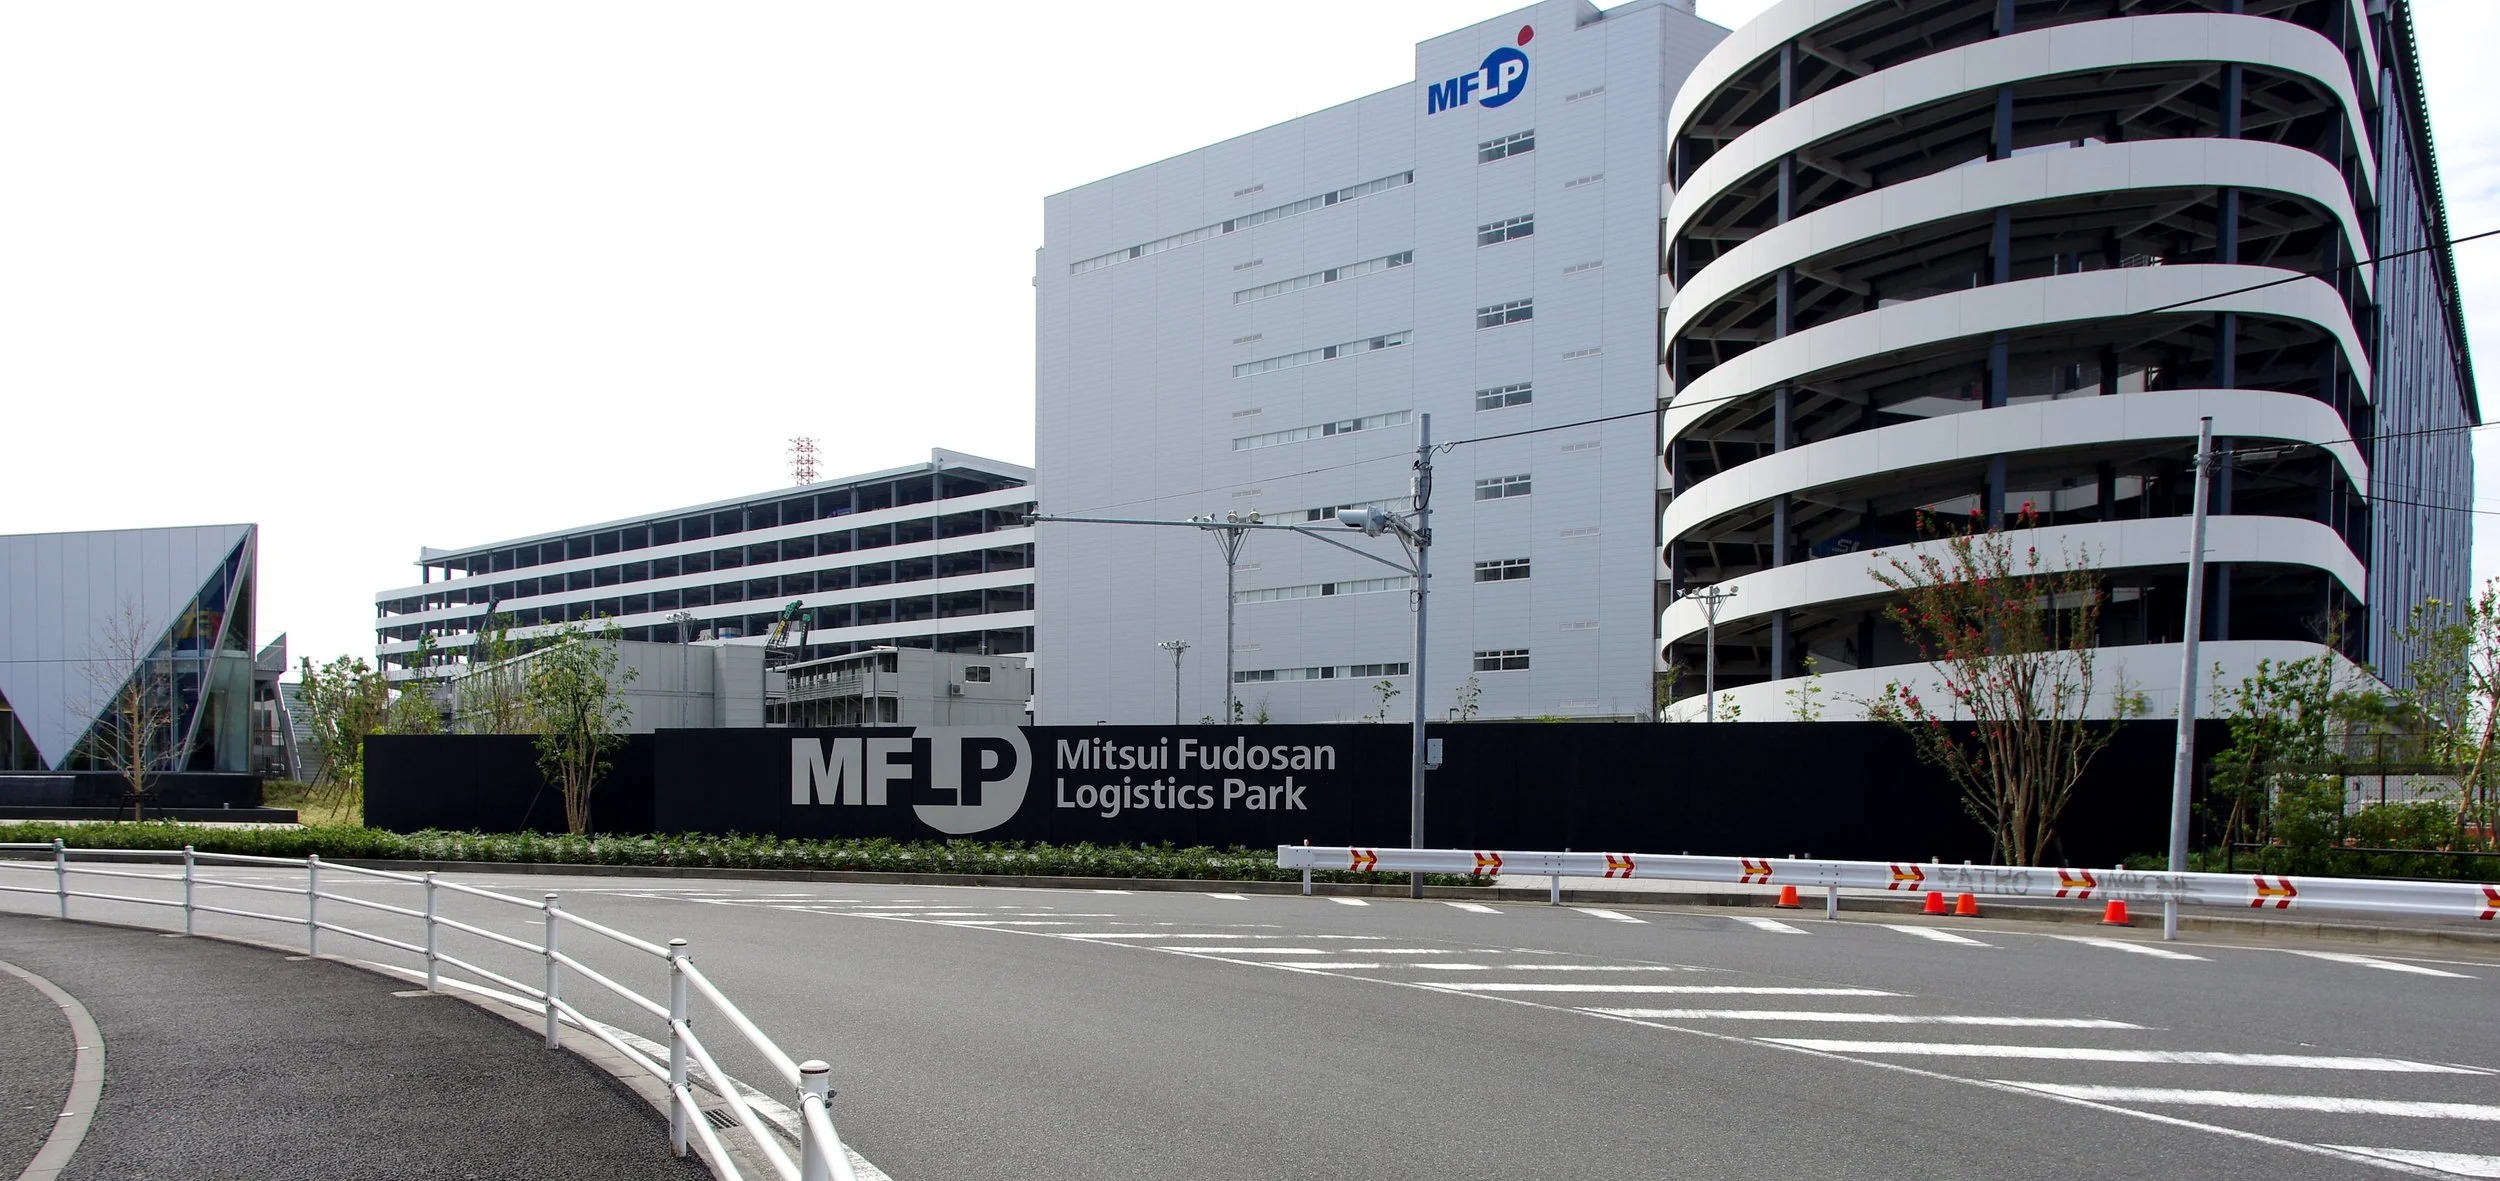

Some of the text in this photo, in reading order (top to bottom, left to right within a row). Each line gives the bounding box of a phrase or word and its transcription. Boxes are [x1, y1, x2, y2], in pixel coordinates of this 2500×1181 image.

[1428, 59, 1524, 115] MFLP
[791, 737, 1018, 806] MFLP
[1056, 736, 1336, 770] Mitsui Fudosan
[1056, 776, 1308, 818] Logistics Park
